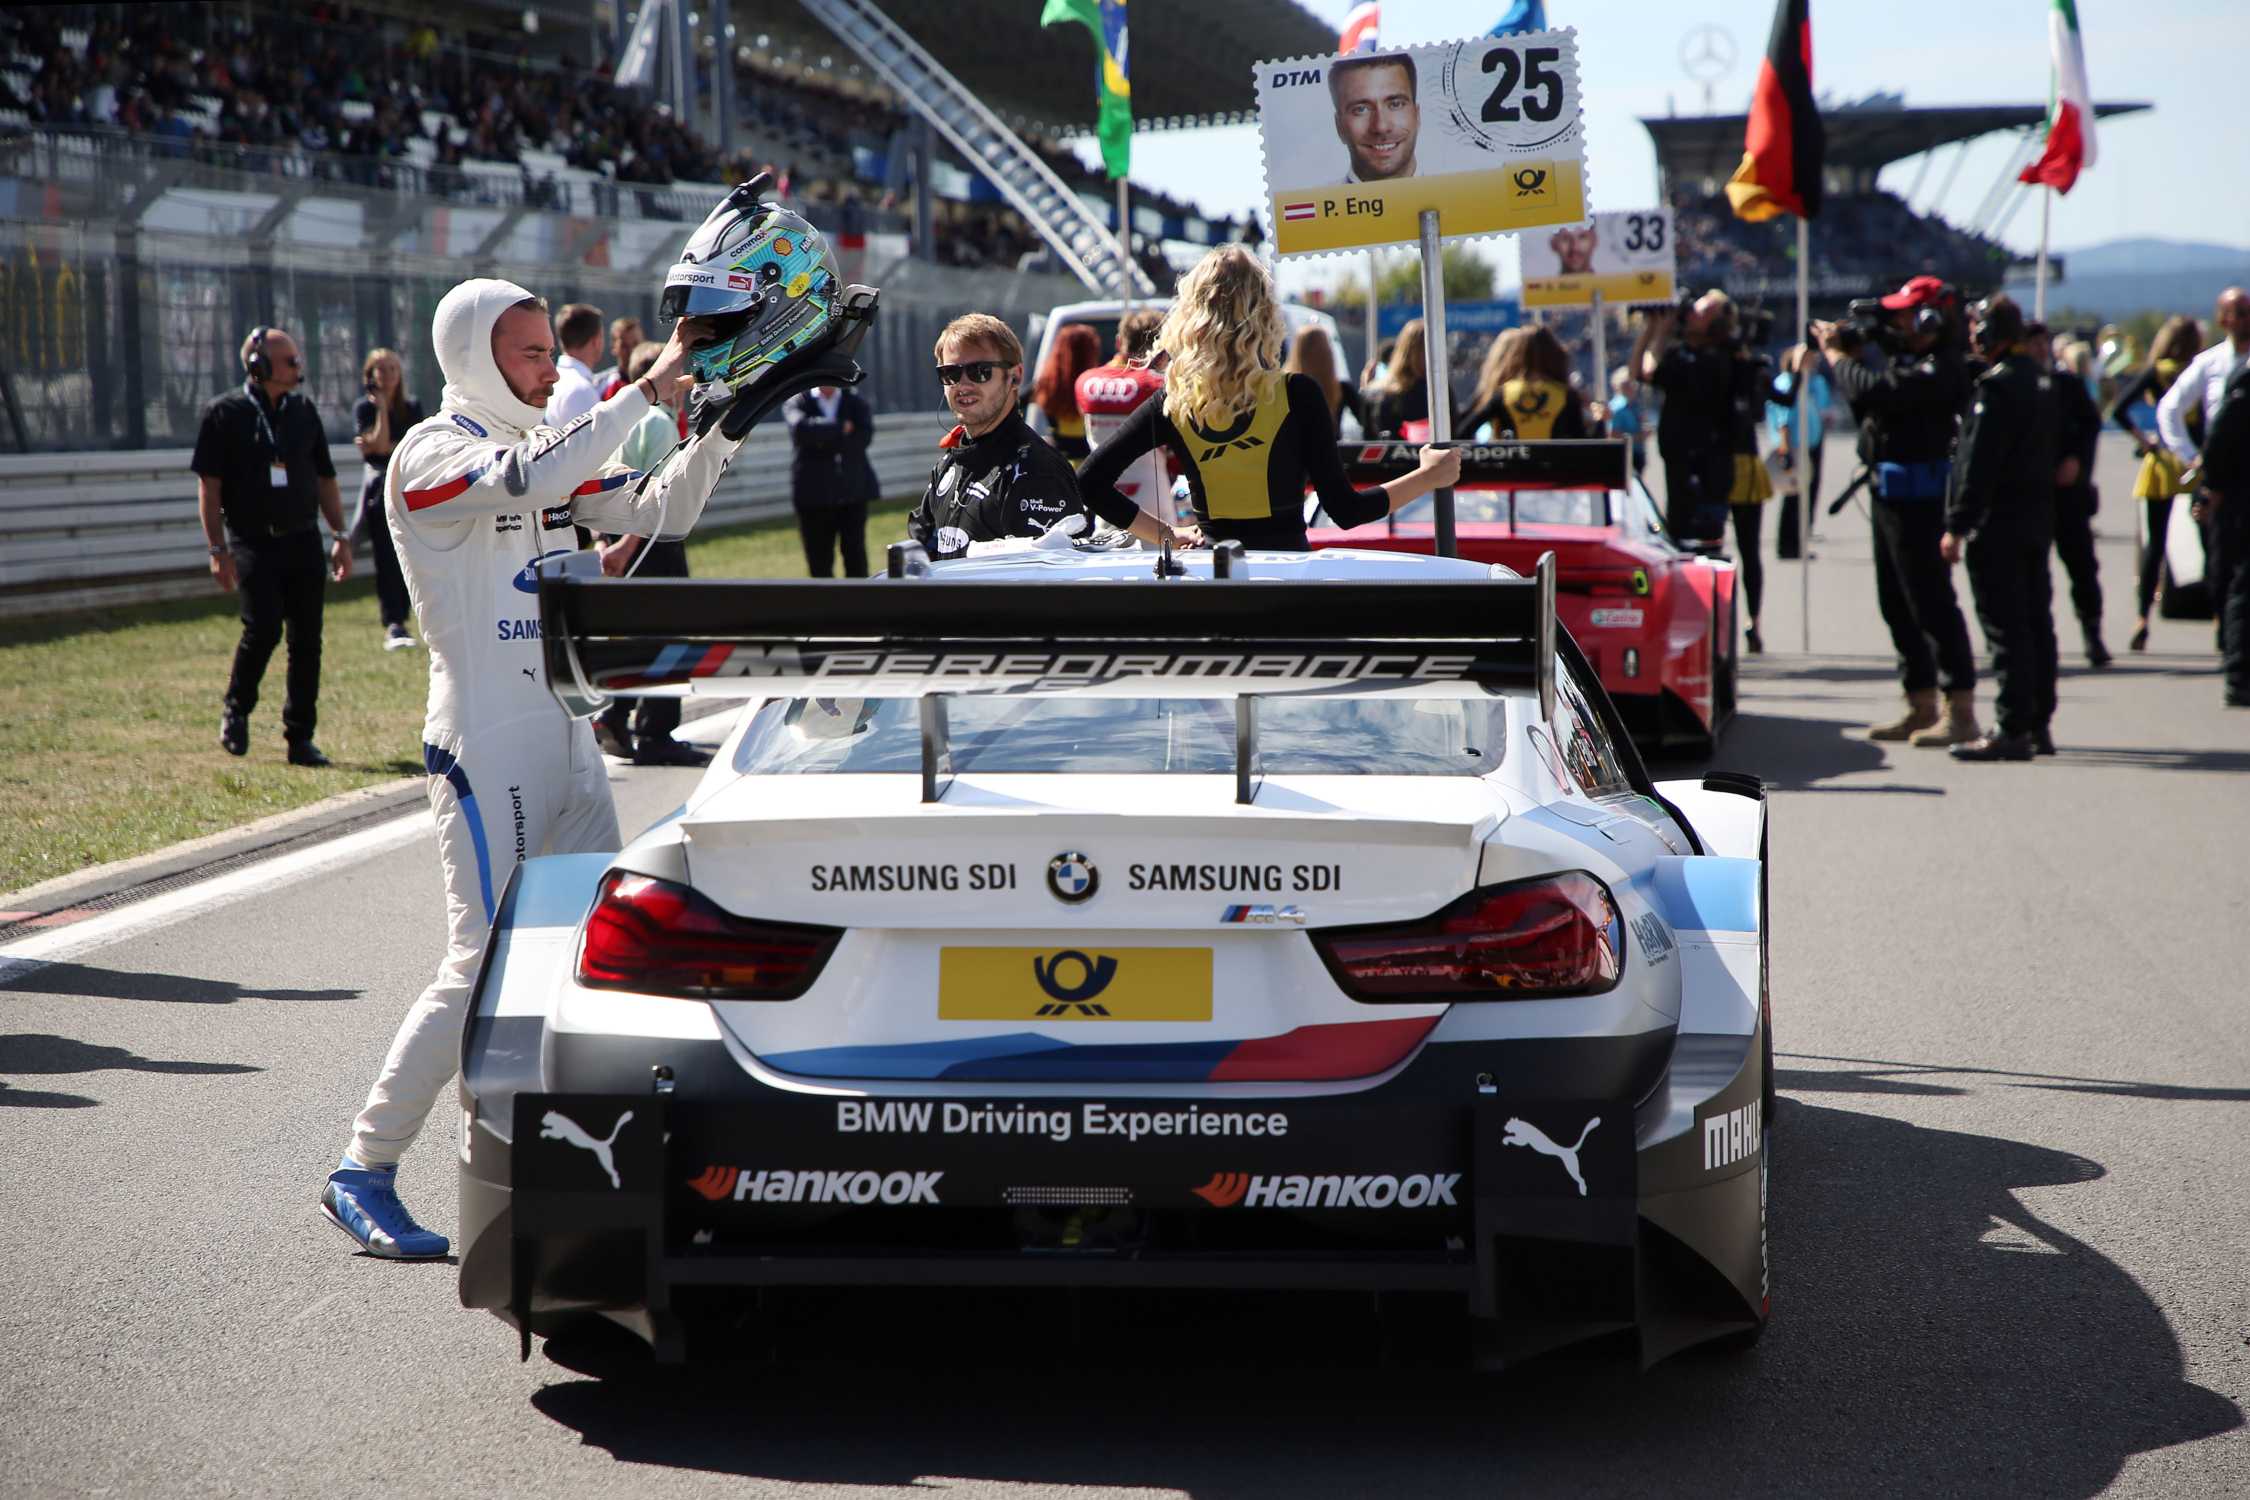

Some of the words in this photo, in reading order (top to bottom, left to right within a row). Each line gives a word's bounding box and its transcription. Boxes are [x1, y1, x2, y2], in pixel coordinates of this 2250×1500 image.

[1271, 69, 1321, 88] DTM
[1481, 47, 1564, 122] 25
[1324, 199, 1339, 217] P.
[1347, 197, 1384, 217] Eng
[1624, 215, 1666, 252] 33
[1460, 443, 1530, 461] Sport
[1030, 504, 1063, 512] V-Power
[809, 653, 1477, 680] PERFORMANCE
[509, 784, 526, 862] otorsport
[810, 864, 959, 892] SAMSUNG
[968, 864, 1016, 891] SDI
[1128, 864, 1286, 892] SAMSUNG
[1292, 864, 1341, 892] SDI
[837, 1101, 934, 1133] BMW
[943, 1102, 1072, 1142] Driving
[1083, 1103, 1289, 1142] Experience
